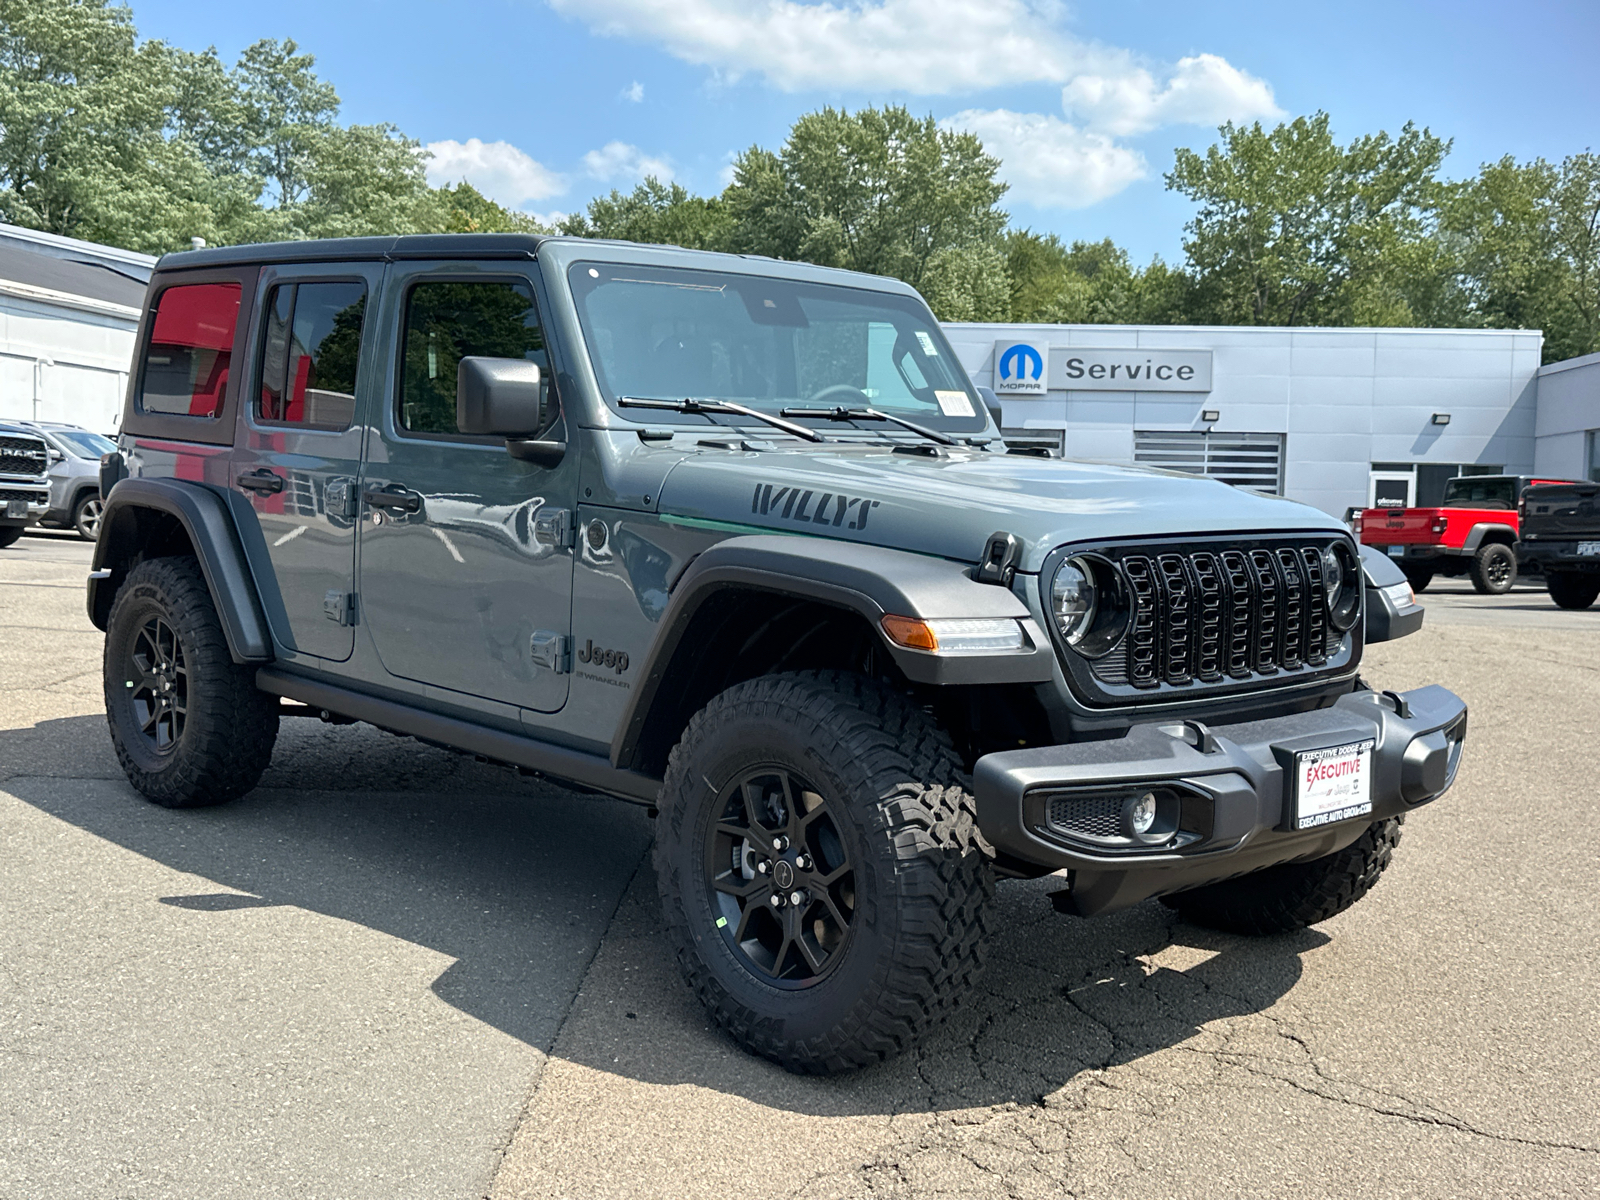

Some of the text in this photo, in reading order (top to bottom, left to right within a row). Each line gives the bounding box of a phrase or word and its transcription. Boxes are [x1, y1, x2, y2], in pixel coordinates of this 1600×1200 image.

[1066, 358, 1194, 380] Service
[752, 483, 880, 530] WILLYS
[1385, 519, 1405, 529] Jeep
[578, 639, 629, 674] Jeep
[585, 672, 630, 689] WRANGLER
[1302, 748, 1338, 761] EXECUTIVE
[1338, 744, 1360, 756] DODGE
[1306, 759, 1361, 792] EXECUTIVE
[1299, 814, 1329, 829] EXECUTIVE
[1328, 810, 1343, 822] AUTO
